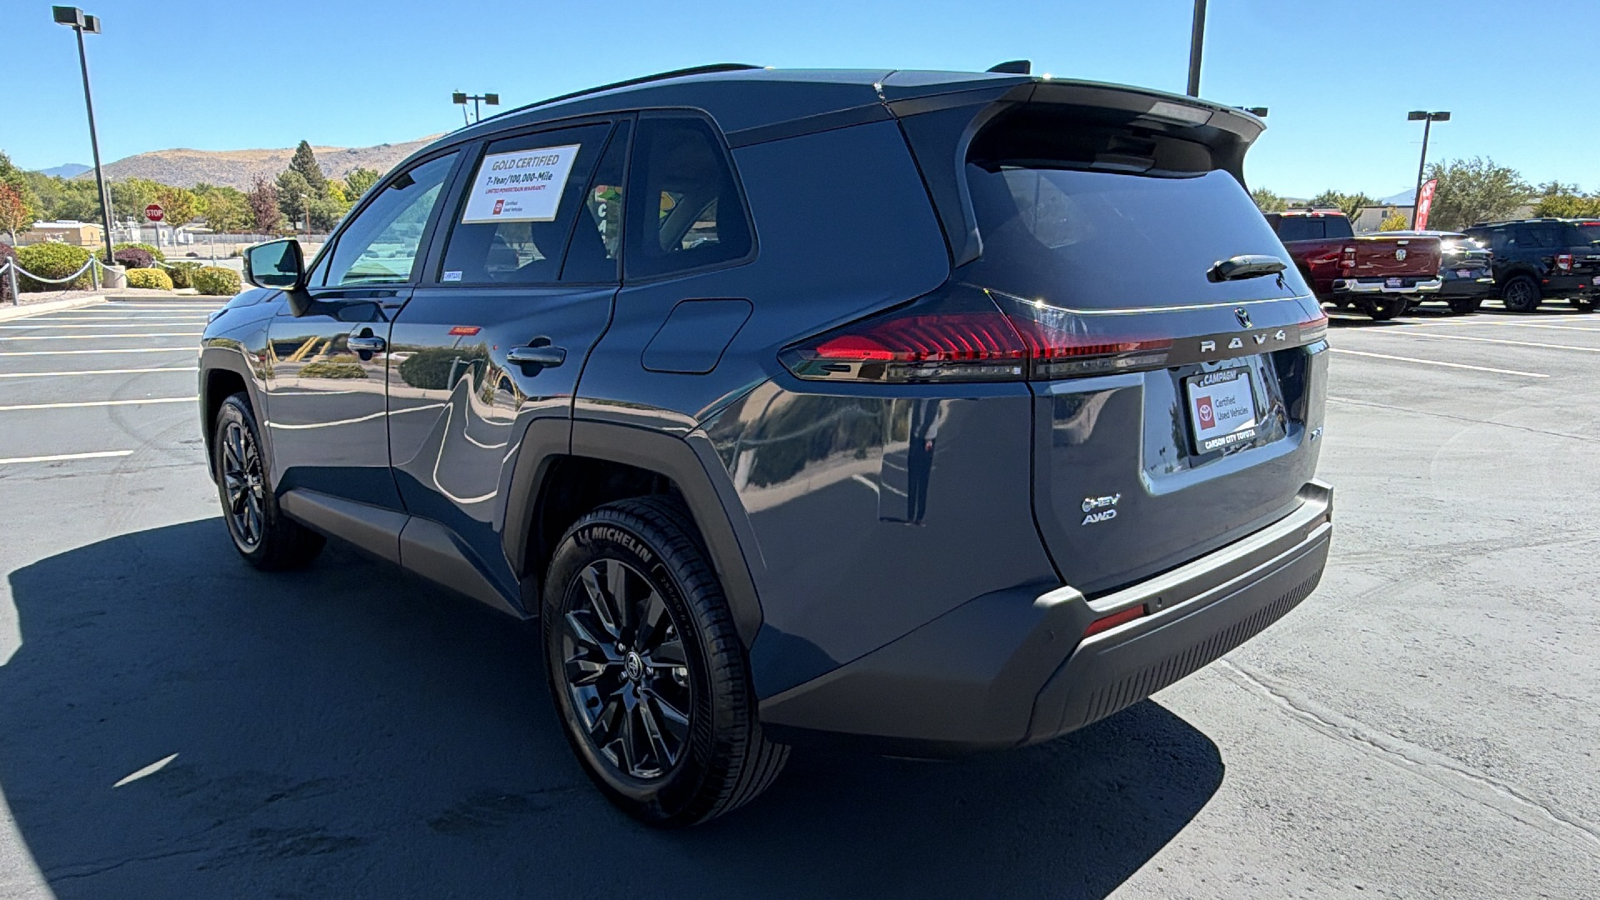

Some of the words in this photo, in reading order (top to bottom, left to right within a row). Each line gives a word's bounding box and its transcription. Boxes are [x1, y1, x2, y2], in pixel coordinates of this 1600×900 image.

[492, 159, 516, 171] GOLD
[515, 154, 560, 169] CERTIFIED
[486, 171, 553, 185] 7-Year/100,000-Mile
[523, 184, 546, 192] WARRANTY
[146, 209, 162, 217] STOP
[1200, 329, 1286, 353] RAV4
[1215, 396, 1236, 408] Certified
[1217, 411, 1230, 421] Used
[1230, 406, 1249, 418] Vehicles
[1205, 437, 1226, 450] CARSON
[1225, 433, 1237, 444] CITY
[1236, 429, 1256, 440] TOYOTA
[1081, 509, 1117, 526] AWD
[592, 527, 653, 563] MICHELIN
